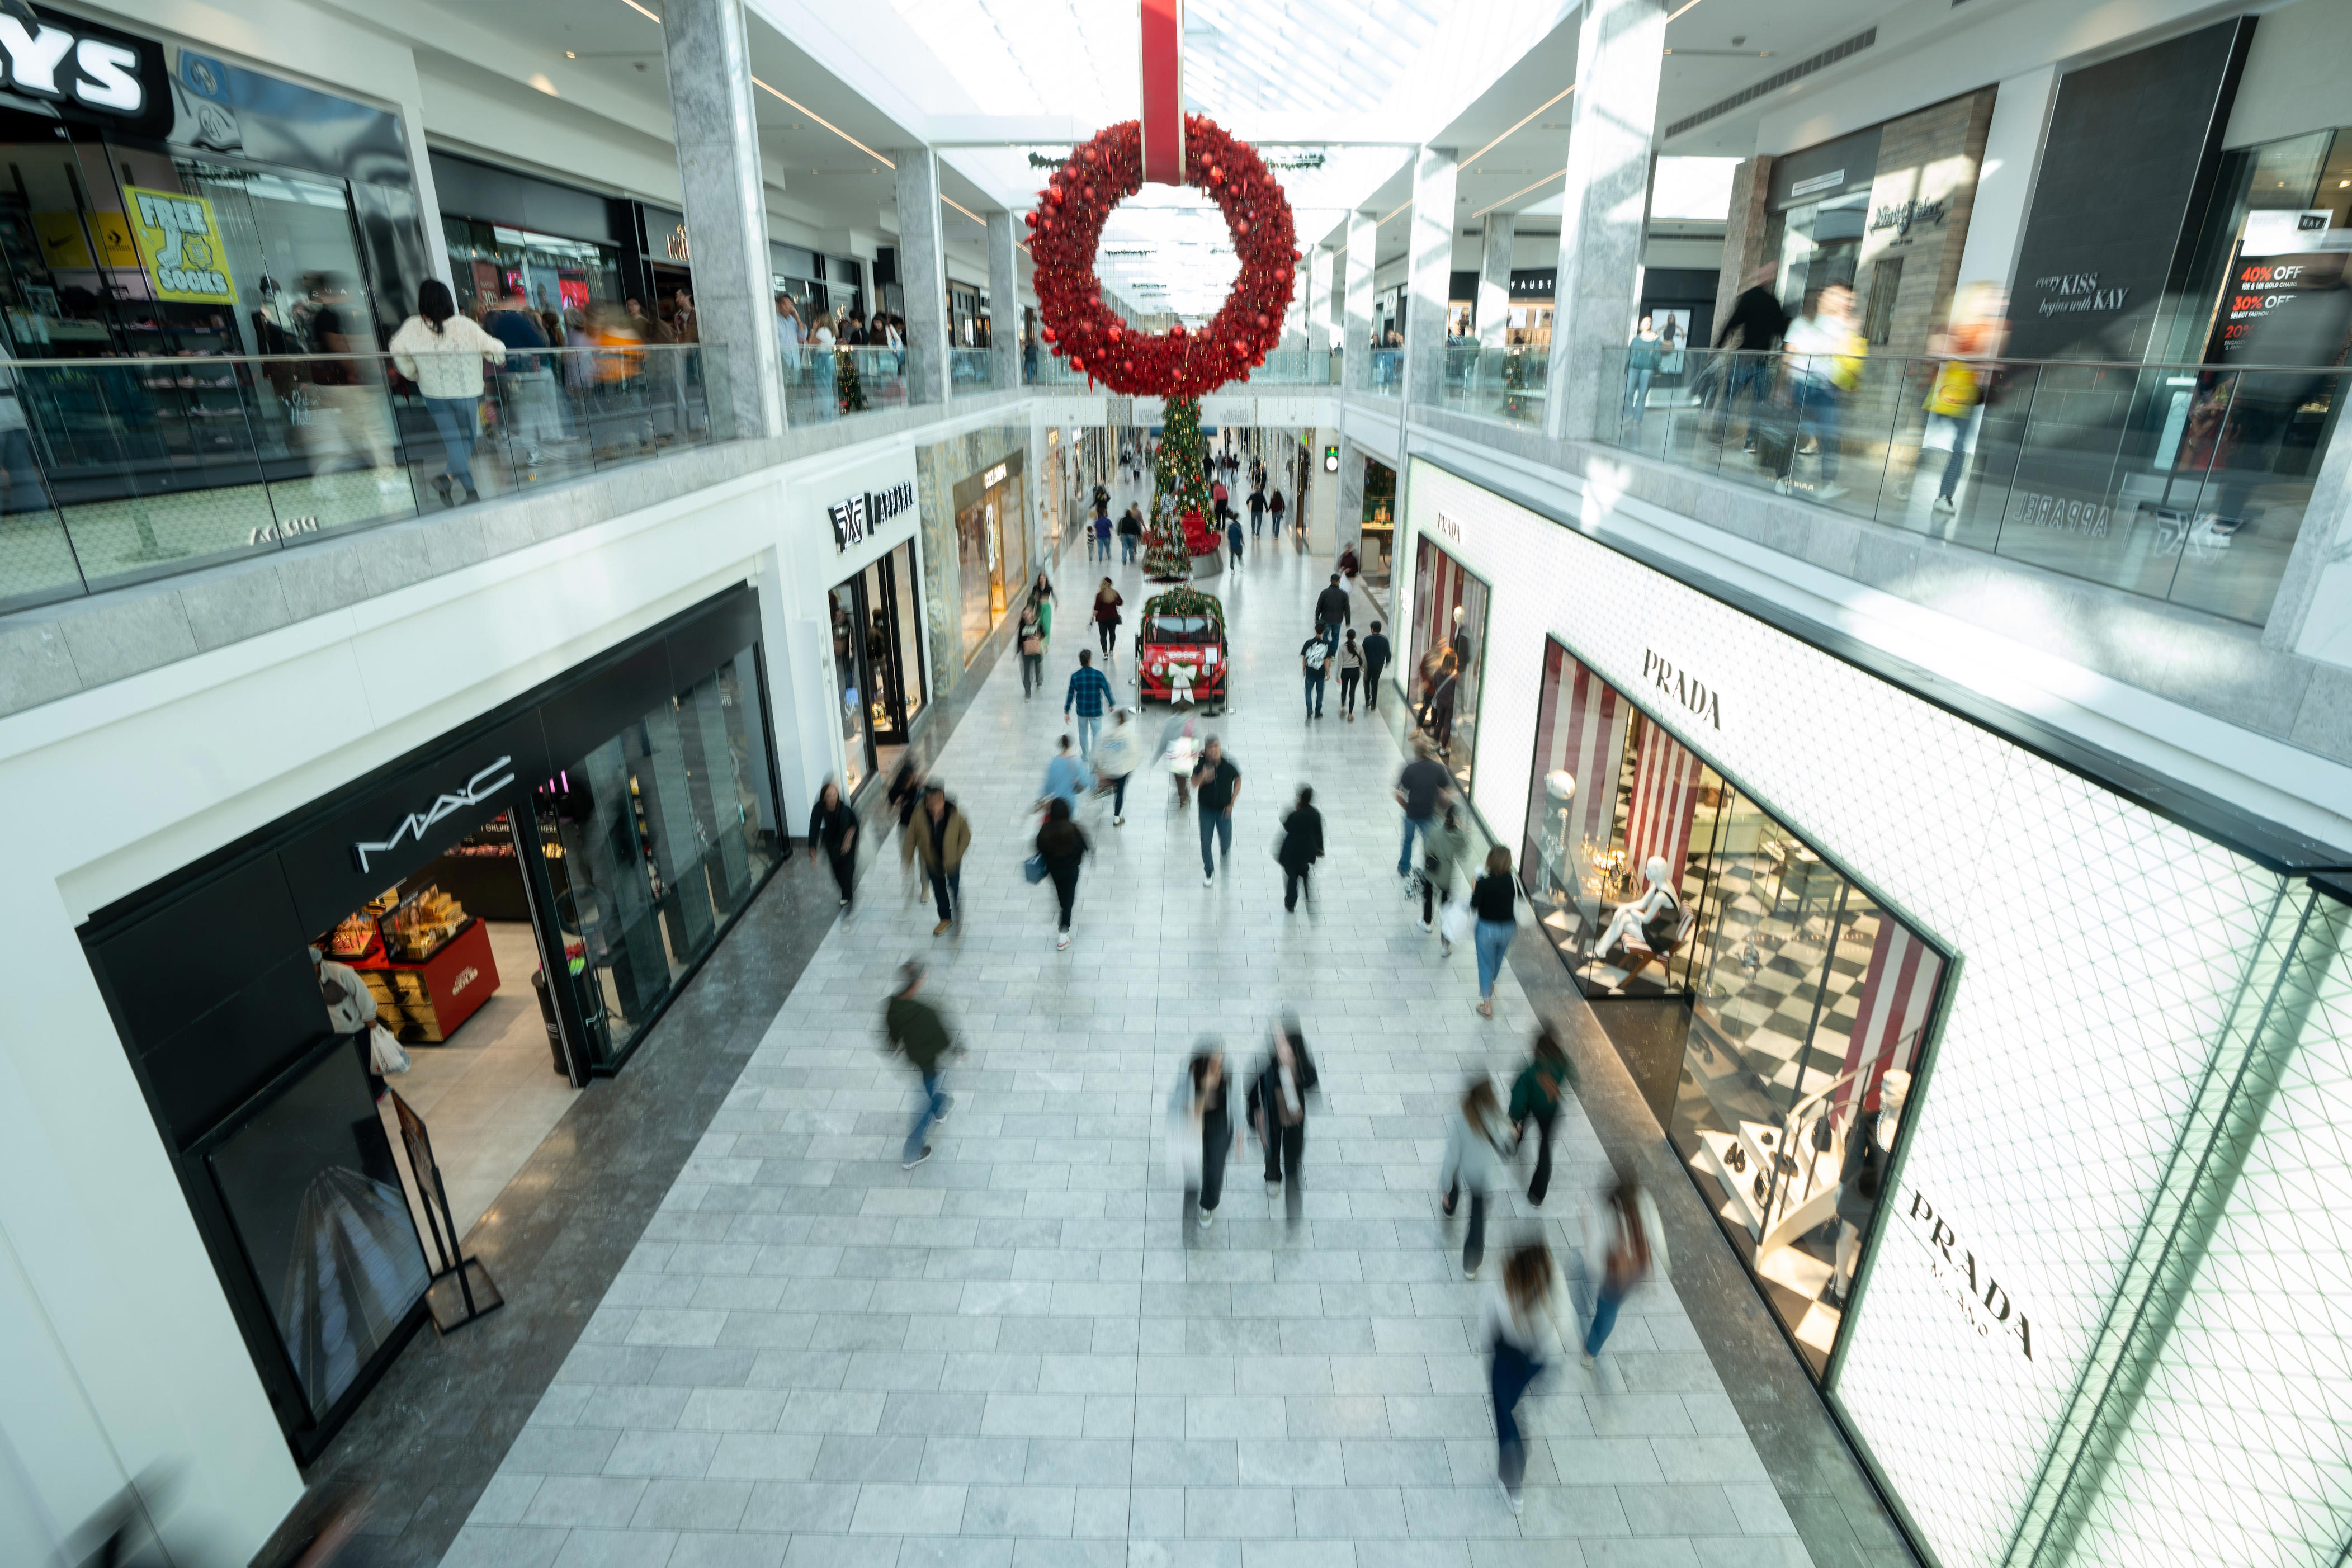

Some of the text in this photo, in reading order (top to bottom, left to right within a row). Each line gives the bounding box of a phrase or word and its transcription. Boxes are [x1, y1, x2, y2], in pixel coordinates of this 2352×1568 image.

[0, 12, 141, 111] YS
[135, 192, 210, 235] FREE
[157, 267, 228, 295] SOCKS
[2035, 272, 2099, 296] every KISS
[2241, 266, 2273, 282] 40%
[2039, 287, 2129, 318] begins with KAY
[2232, 295, 2264, 311] 30%
[2224, 324, 2255, 339] 20%
[874, 479, 915, 526] APPAREL
[1438, 511, 1460, 545] PRADA
[1643, 647, 1720, 731] PRADA
[485, 824, 510, 832] ONLINE
[540, 824, 558, 833] HERE
[1909, 1189, 2033, 1363] PRADA
